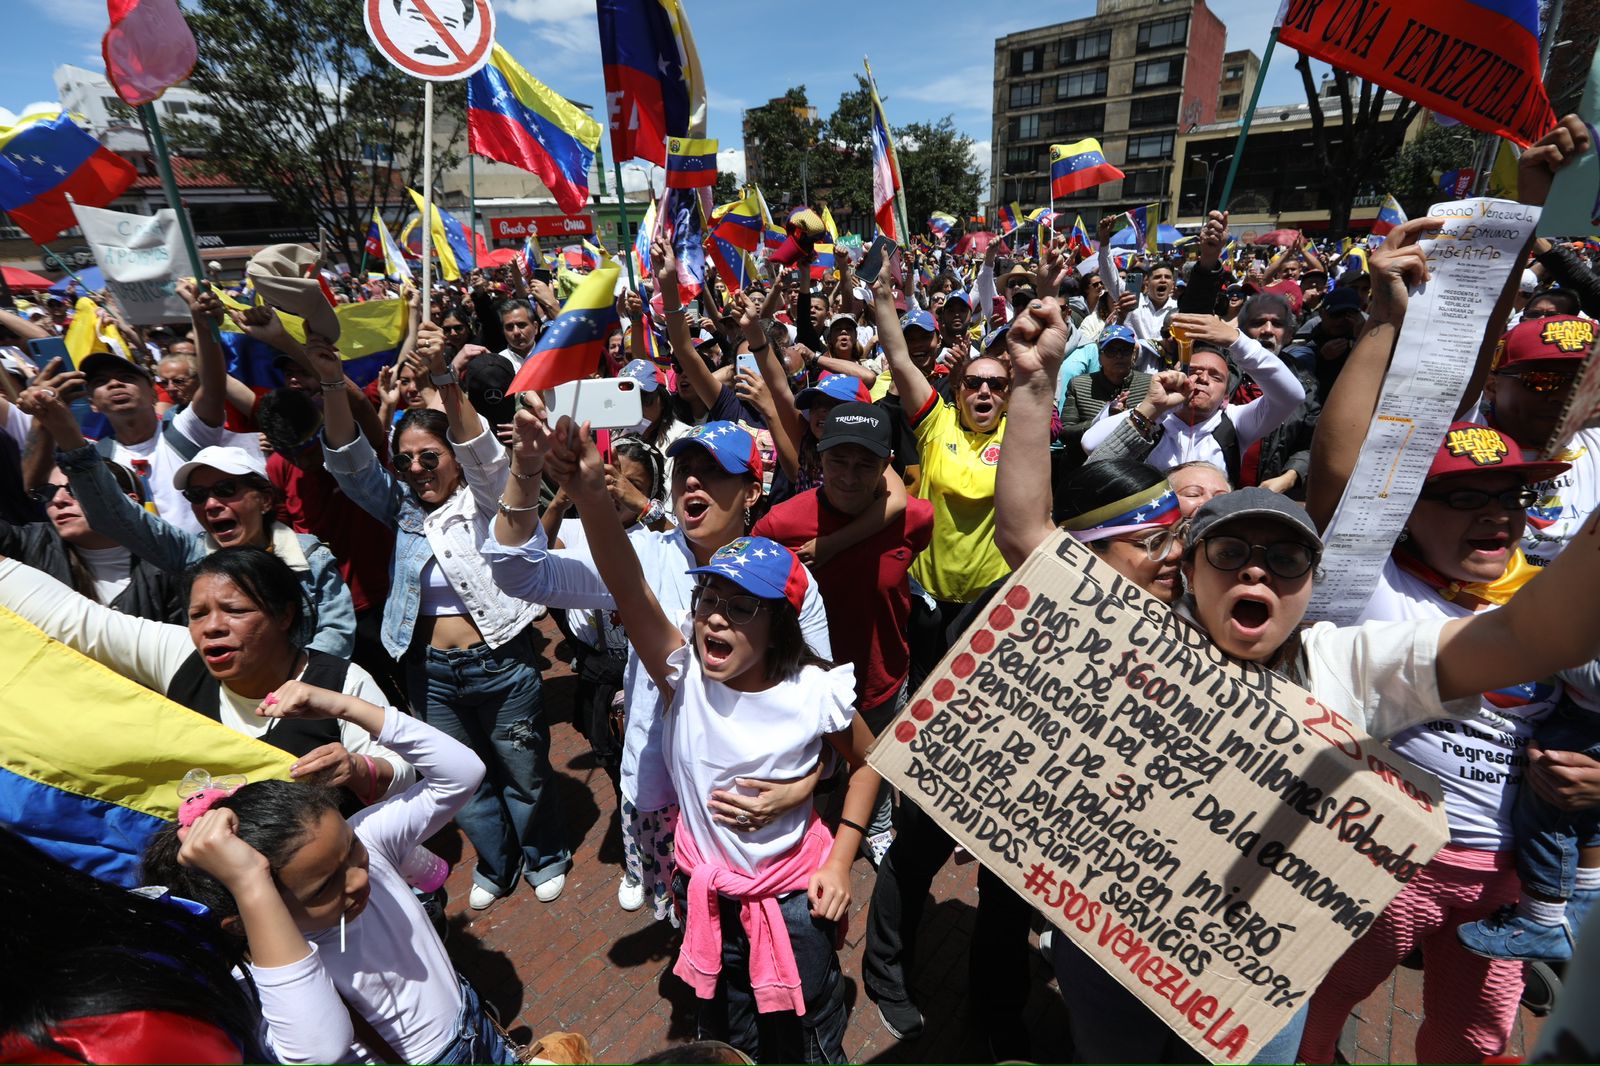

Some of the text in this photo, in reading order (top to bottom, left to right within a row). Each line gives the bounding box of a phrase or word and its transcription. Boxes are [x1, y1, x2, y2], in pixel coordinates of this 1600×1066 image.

[1322, 0, 1391, 59] UNA
[1383, 17, 1534, 127] VENEZUELA
[1481, 202, 1533, 223] Venezuela
[1459, 225, 1520, 241] EDMUNDO
[1542, 330, 1593, 343] TENGO
[1547, 321, 1591, 333] MANO
[1559, 339, 1584, 350] FE
[835, 415, 870, 424] TRIUMPH
[1447, 438, 1507, 454] TENGO
[1449, 428, 1500, 441] MANO
[1471, 449, 1501, 463] FE
[1007, 616, 1075, 666] 90%
[1055, 536, 1101, 585] EL
[1302, 696, 1364, 761] 25
[1367, 754, 1433, 814] años
[965, 660, 1072, 752] Pensiones
[1105, 773, 1154, 814] 3$
[946, 688, 1006, 735] 25%
[1036, 752, 1072, 791] la
[1061, 778, 1182, 882] población
[1143, 753, 1206, 801] 80%
[1215, 729, 1338, 825] millones
[1078, 862, 1104, 891] Y
[1135, 875, 1174, 914] en
[1173, 904, 1308, 1010] 6.620.209%
